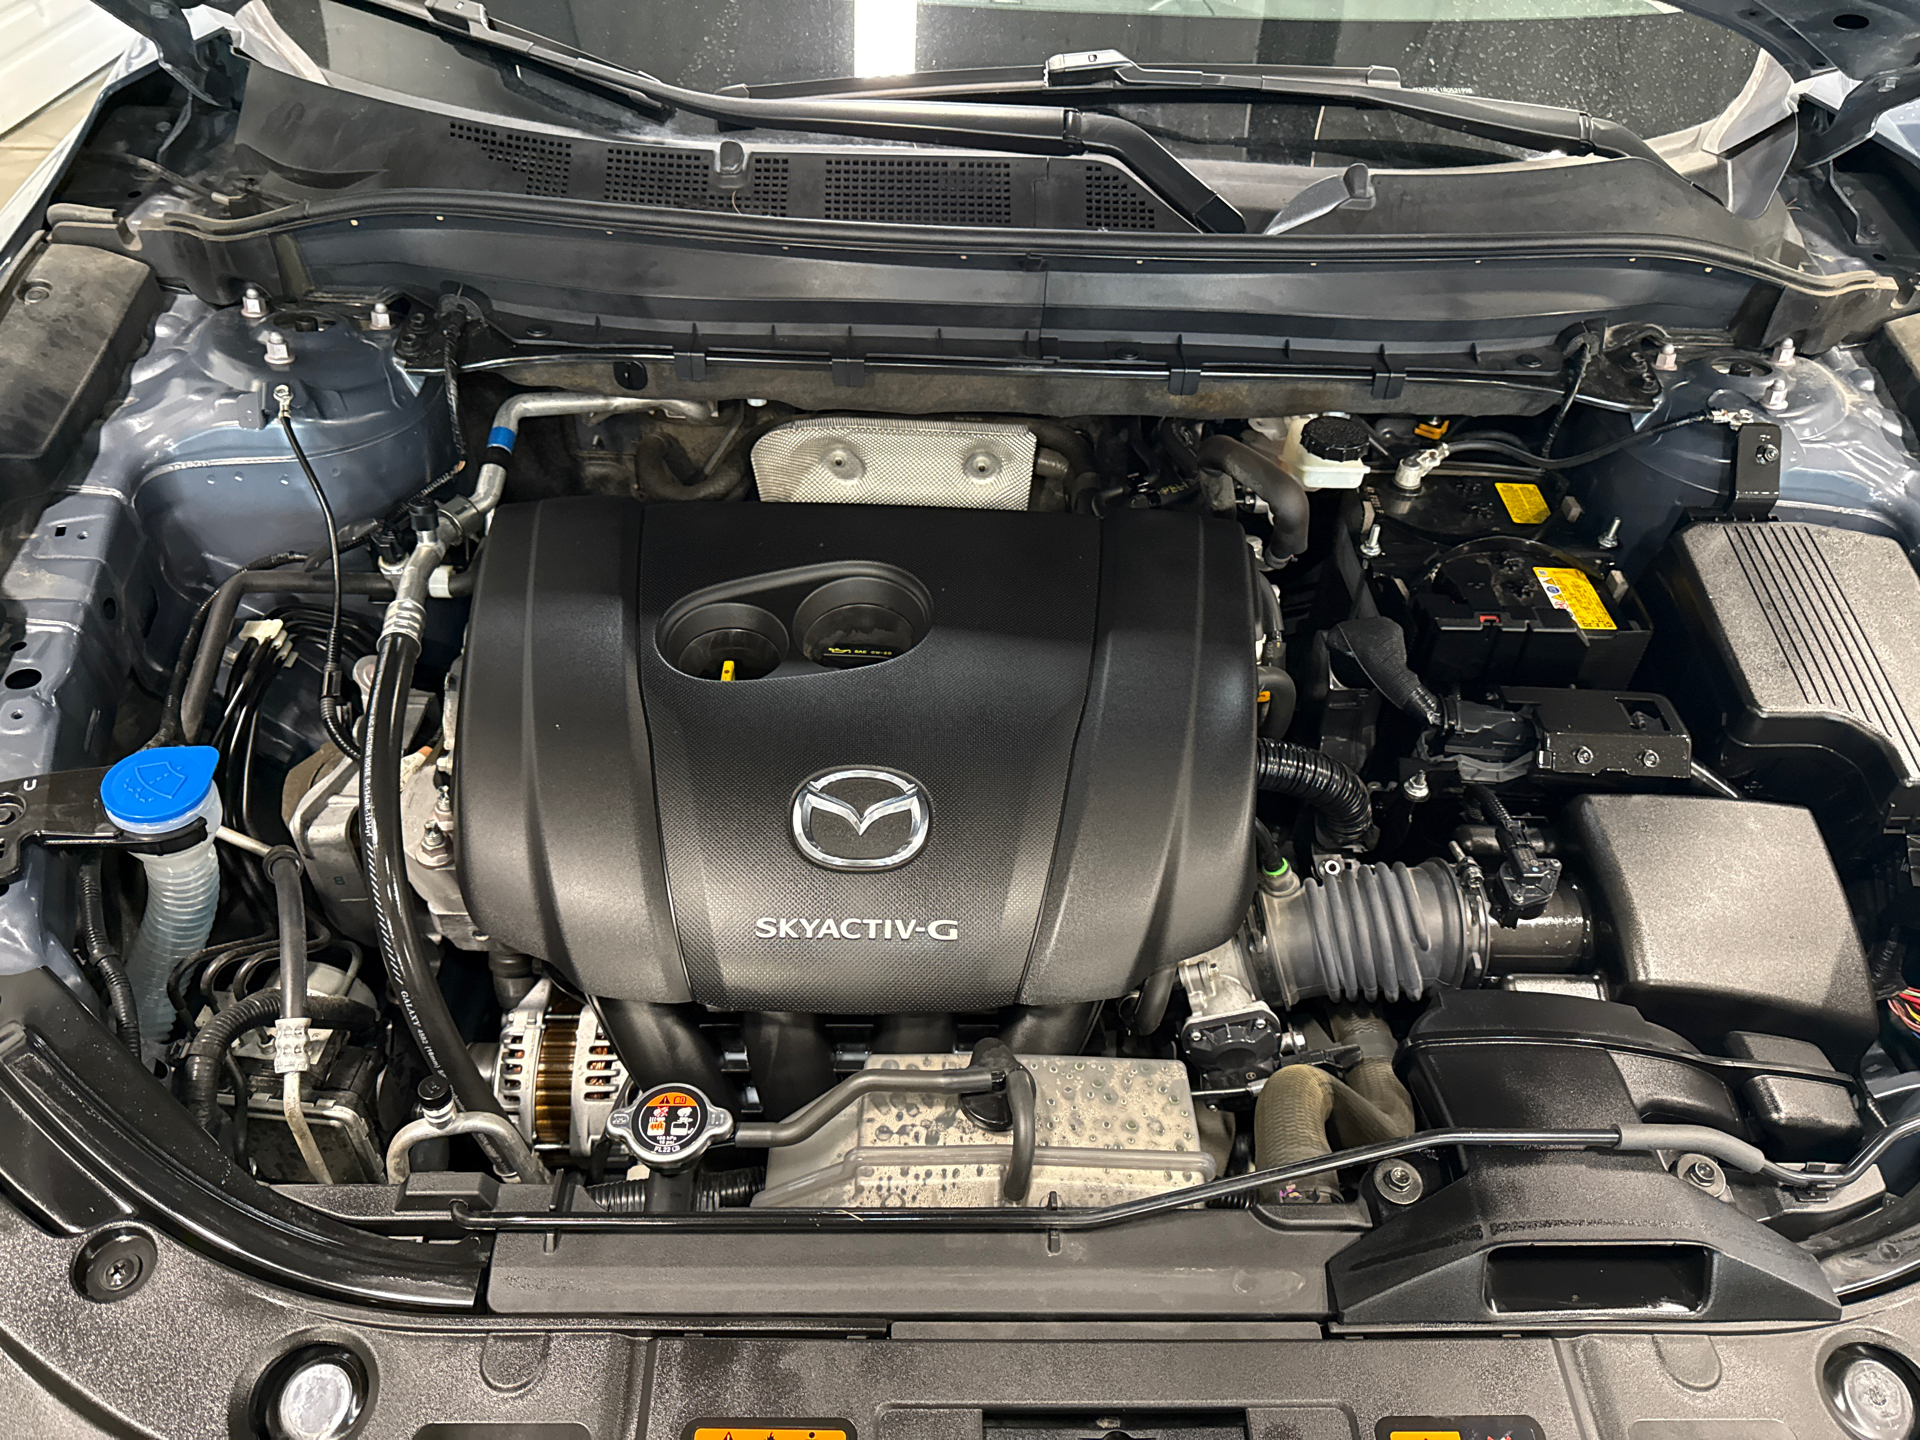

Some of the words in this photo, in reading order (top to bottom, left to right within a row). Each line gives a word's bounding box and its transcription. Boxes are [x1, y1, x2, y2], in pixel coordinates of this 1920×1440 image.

[365, 727, 375, 757] SUCTION
[364, 757, 372, 777] HOSE
[755, 917, 959, 941] SKYACTIV-G
[400, 990, 422, 1027] GALAXY
